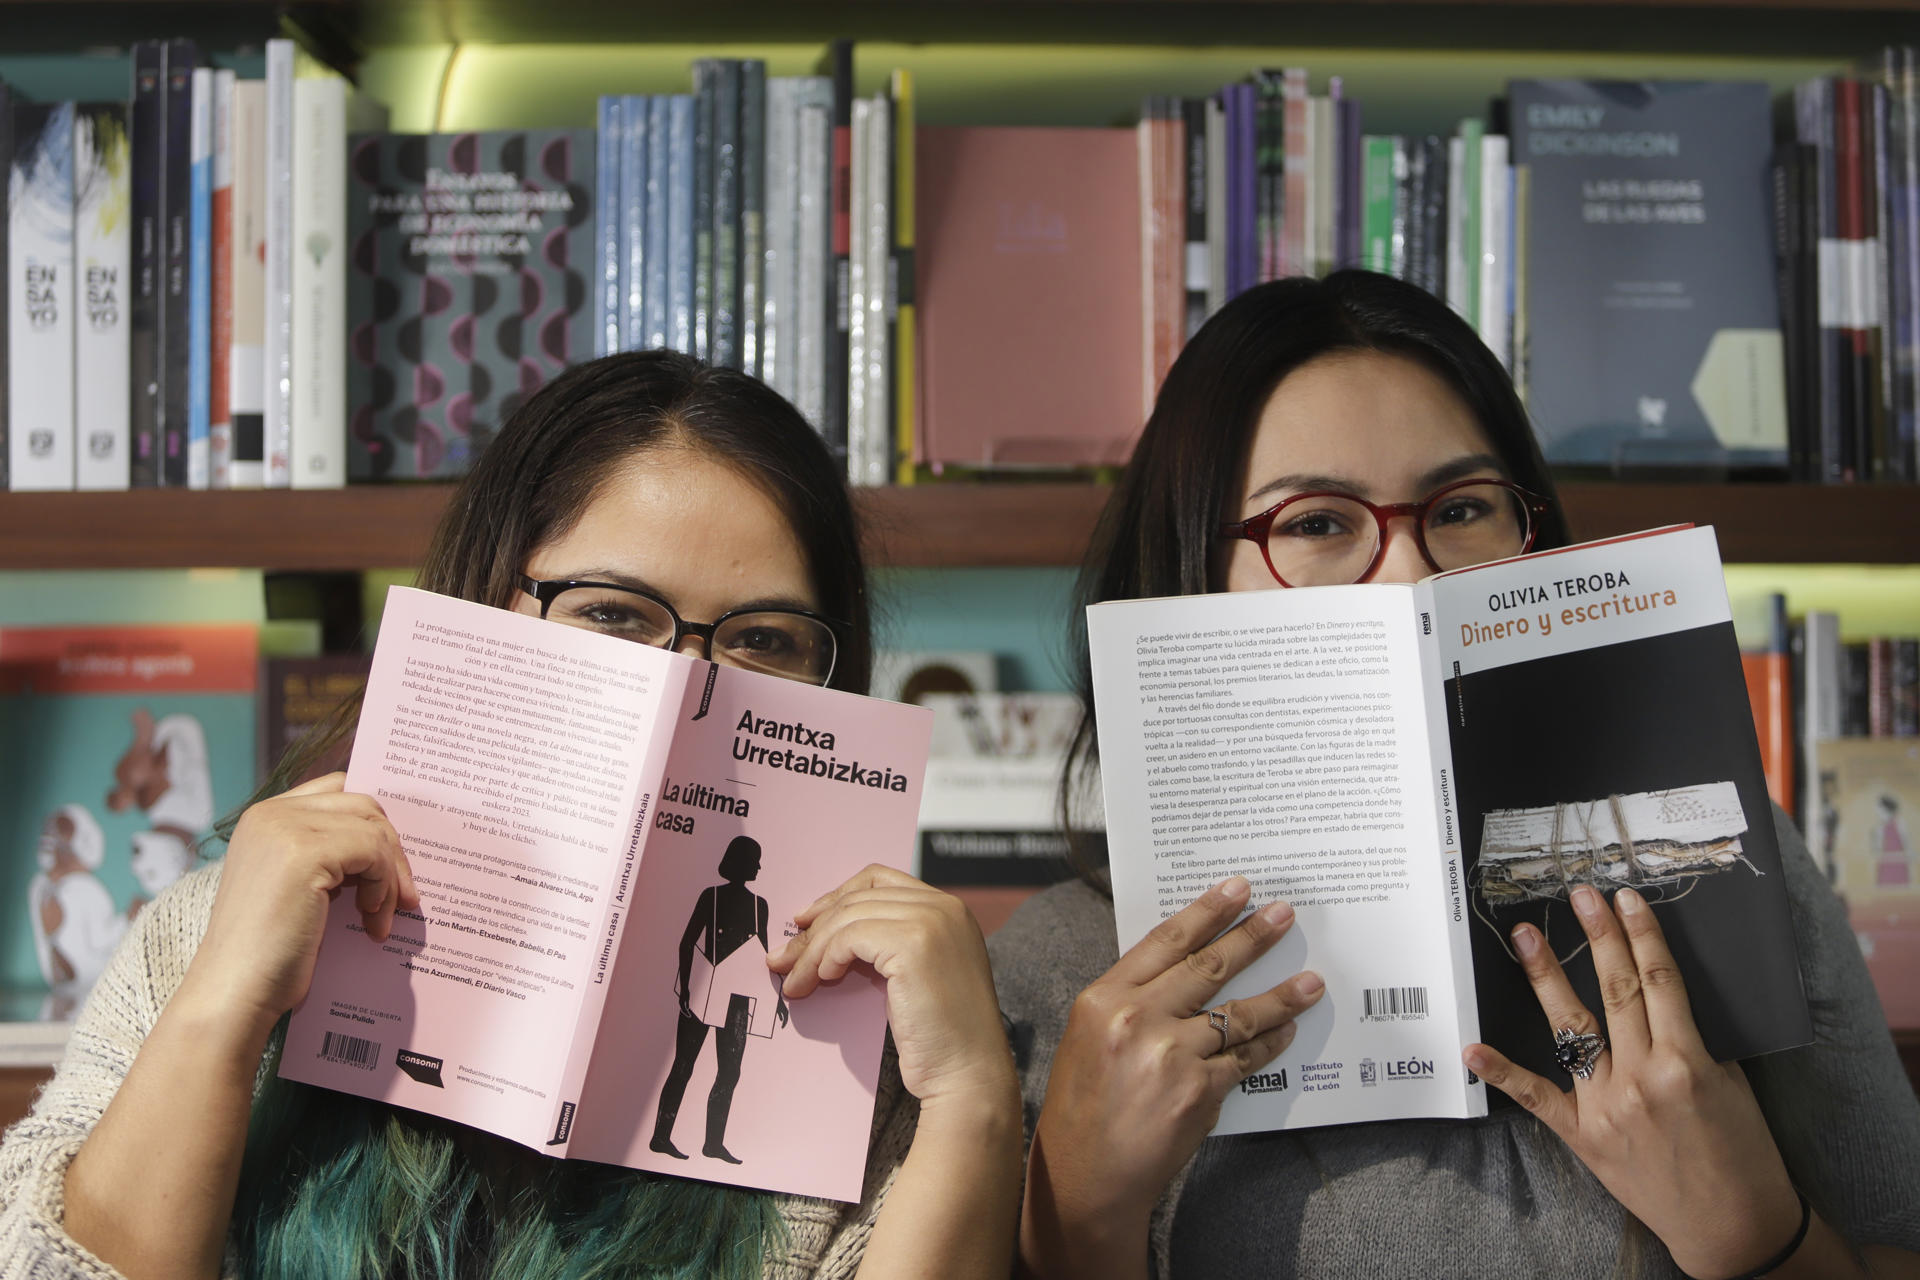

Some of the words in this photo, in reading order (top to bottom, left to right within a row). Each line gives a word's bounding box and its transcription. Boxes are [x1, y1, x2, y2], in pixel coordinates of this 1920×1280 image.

[1528, 103, 1604, 128] EMILY
[1528, 131, 1680, 156] DICKINSON
[26, 266, 56, 283] EN
[86, 266, 117, 283] EN
[26, 286, 55, 304] SA
[86, 286, 117, 304] SA
[27, 308, 57, 326] YO
[87, 308, 118, 326] YO
[1488, 586, 1549, 612] OLIVIA
[1553, 570, 1630, 599] TEROBA
[1460, 617, 1530, 647] Dinero
[1538, 614, 1551, 636] y
[1560, 589, 1678, 625] escritura
[1136, 646, 1158, 655] Olivia
[1158, 643, 1184, 653] Teroba
[1185, 641, 1223, 651] comparte
[1258, 636, 1285, 645] mirada
[1286, 635, 1307, 643] sobre
[1308, 634, 1319, 642] las
[1320, 631, 1372, 642] complejidades
[1372, 632, 1386, 640] que
[701, 669, 716, 712] consonni
[1146, 694, 1156, 702] las
[1158, 691, 1194, 701] herencias
[395, 703, 409, 713] Sin
[410, 708, 423, 717] ser
[435, 713, 463, 726] thriller
[470, 723, 486, 731] una
[486, 726, 512, 738] novela
[538, 739, 547, 747] en
[1142, 719, 1161, 727] duce
[1162, 718, 1175, 727] por
[1176, 715, 1211, 724] tortuosas
[1212, 711, 1248, 721] consultas
[1302, 704, 1371, 715] experimentaciones
[736, 709, 836, 751] Arantxa
[732, 736, 908, 793] Urretabizkaia
[662, 778, 680, 802] La
[682, 782, 750, 817] última
[1159, 789, 1189, 797] entorno
[1190, 784, 1221, 795] material
[1228, 781, 1264, 792] espiritual
[1297, 777, 1319, 786] visión
[1368, 776, 1382, 784] que
[1440, 769, 1450, 807] escritura
[655, 811, 695, 835] casa
[1445, 815, 1454, 845] Dinero
[615, 862, 633, 903] Arantxa
[626, 793, 650, 861] Urretabizkaia
[1449, 859, 1459, 896] TEROBA
[1453, 896, 1462, 922] Olivia
[393, 907, 428, 922] Kortazar
[434, 917, 450, 927] Jon
[545, 947, 553, 956] El
[594, 972, 604, 984] La
[600, 938, 613, 971] última
[608, 912, 620, 936] casa
[430, 967, 473, 986] Azurmendi,
[474, 979, 484, 988] El
[482, 981, 505, 994] Diario
[504, 987, 526, 1000] Vasco
[328, 1007, 351, 1019] Sonia
[351, 1012, 376, 1025] Pulido
[400, 1054, 440, 1070] consonni
[1301, 1062, 1343, 1072] Instituto
[1387, 1056, 1434, 1075] LEÓN
[1240, 1068, 1288, 1093] fenal
[1302, 1072, 1340, 1081] Cultural
[1317, 1083, 1340, 1091] León
[558, 1104, 572, 1140] consonni
